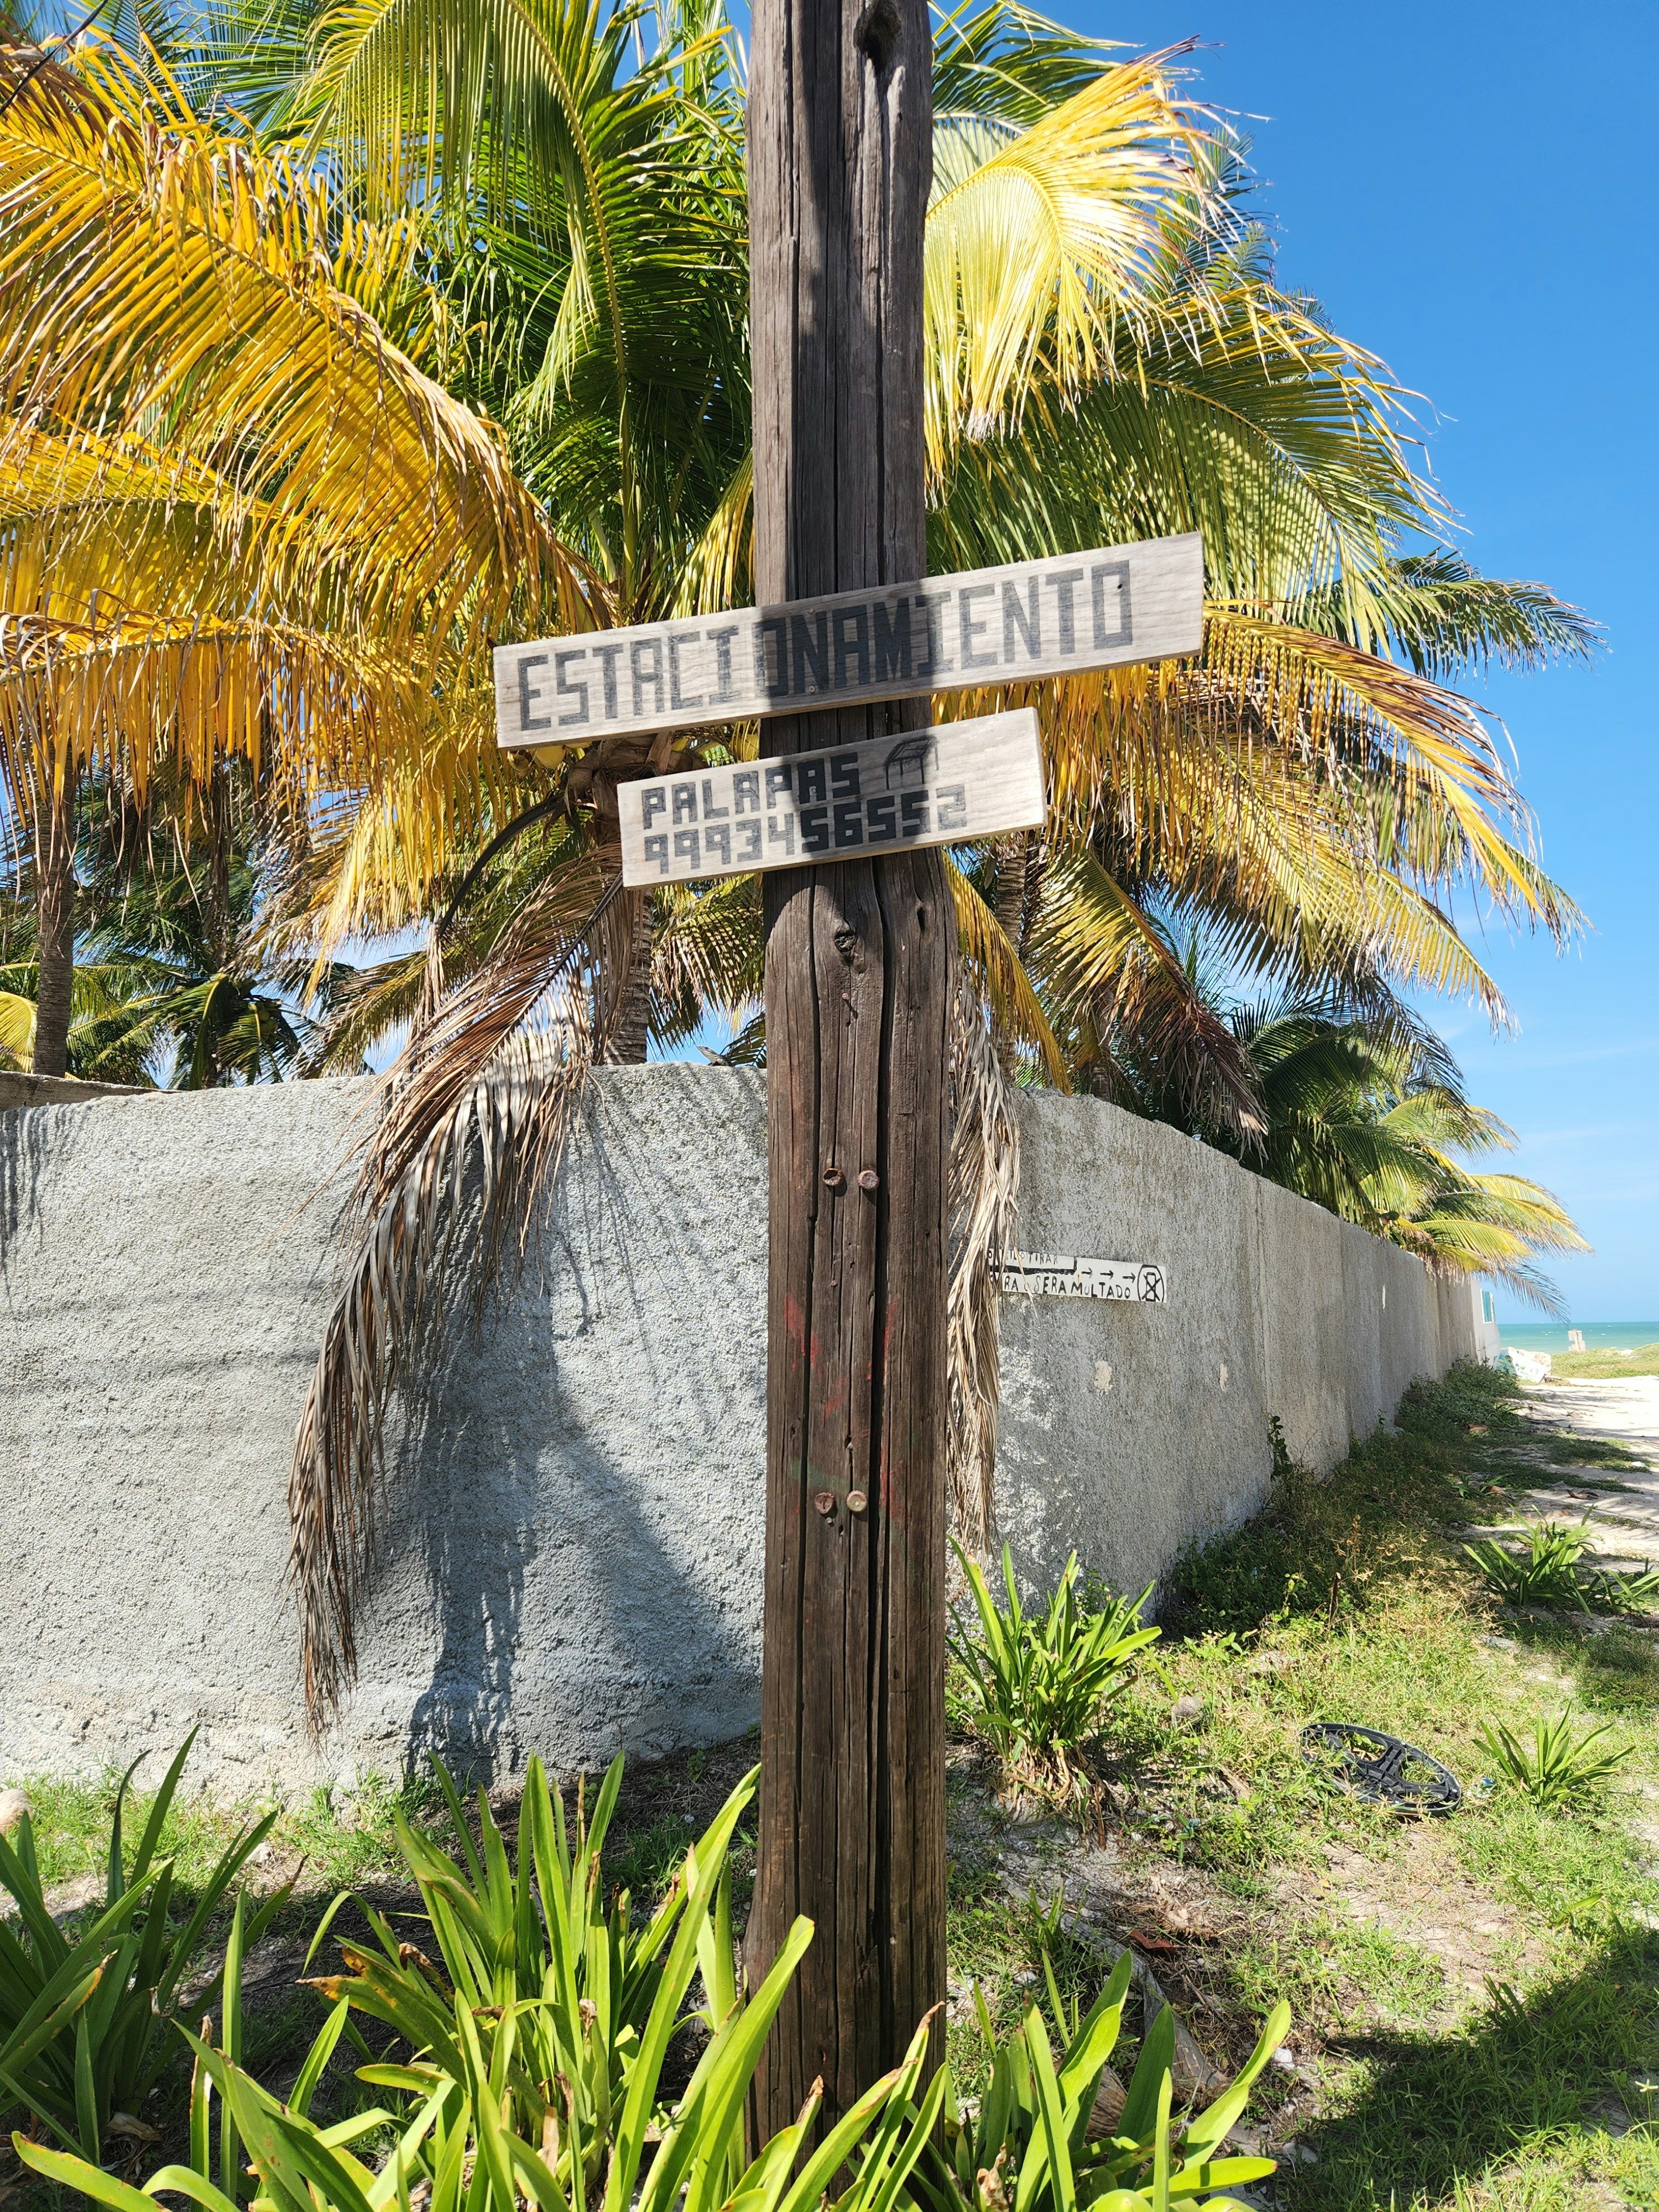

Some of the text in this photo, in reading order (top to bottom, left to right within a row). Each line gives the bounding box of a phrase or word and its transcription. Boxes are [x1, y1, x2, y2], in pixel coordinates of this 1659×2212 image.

[519, 559, 1133, 731] ESTACIONAMIENTO
[641, 752, 860, 830] PALAPAS
[644, 785, 967, 874] 9993456552
[1029, 1251, 1058, 1265] TIRAR
[1034, 1275, 1067, 1294] SERA
[1071, 1281, 1131, 1300] MULTADO
